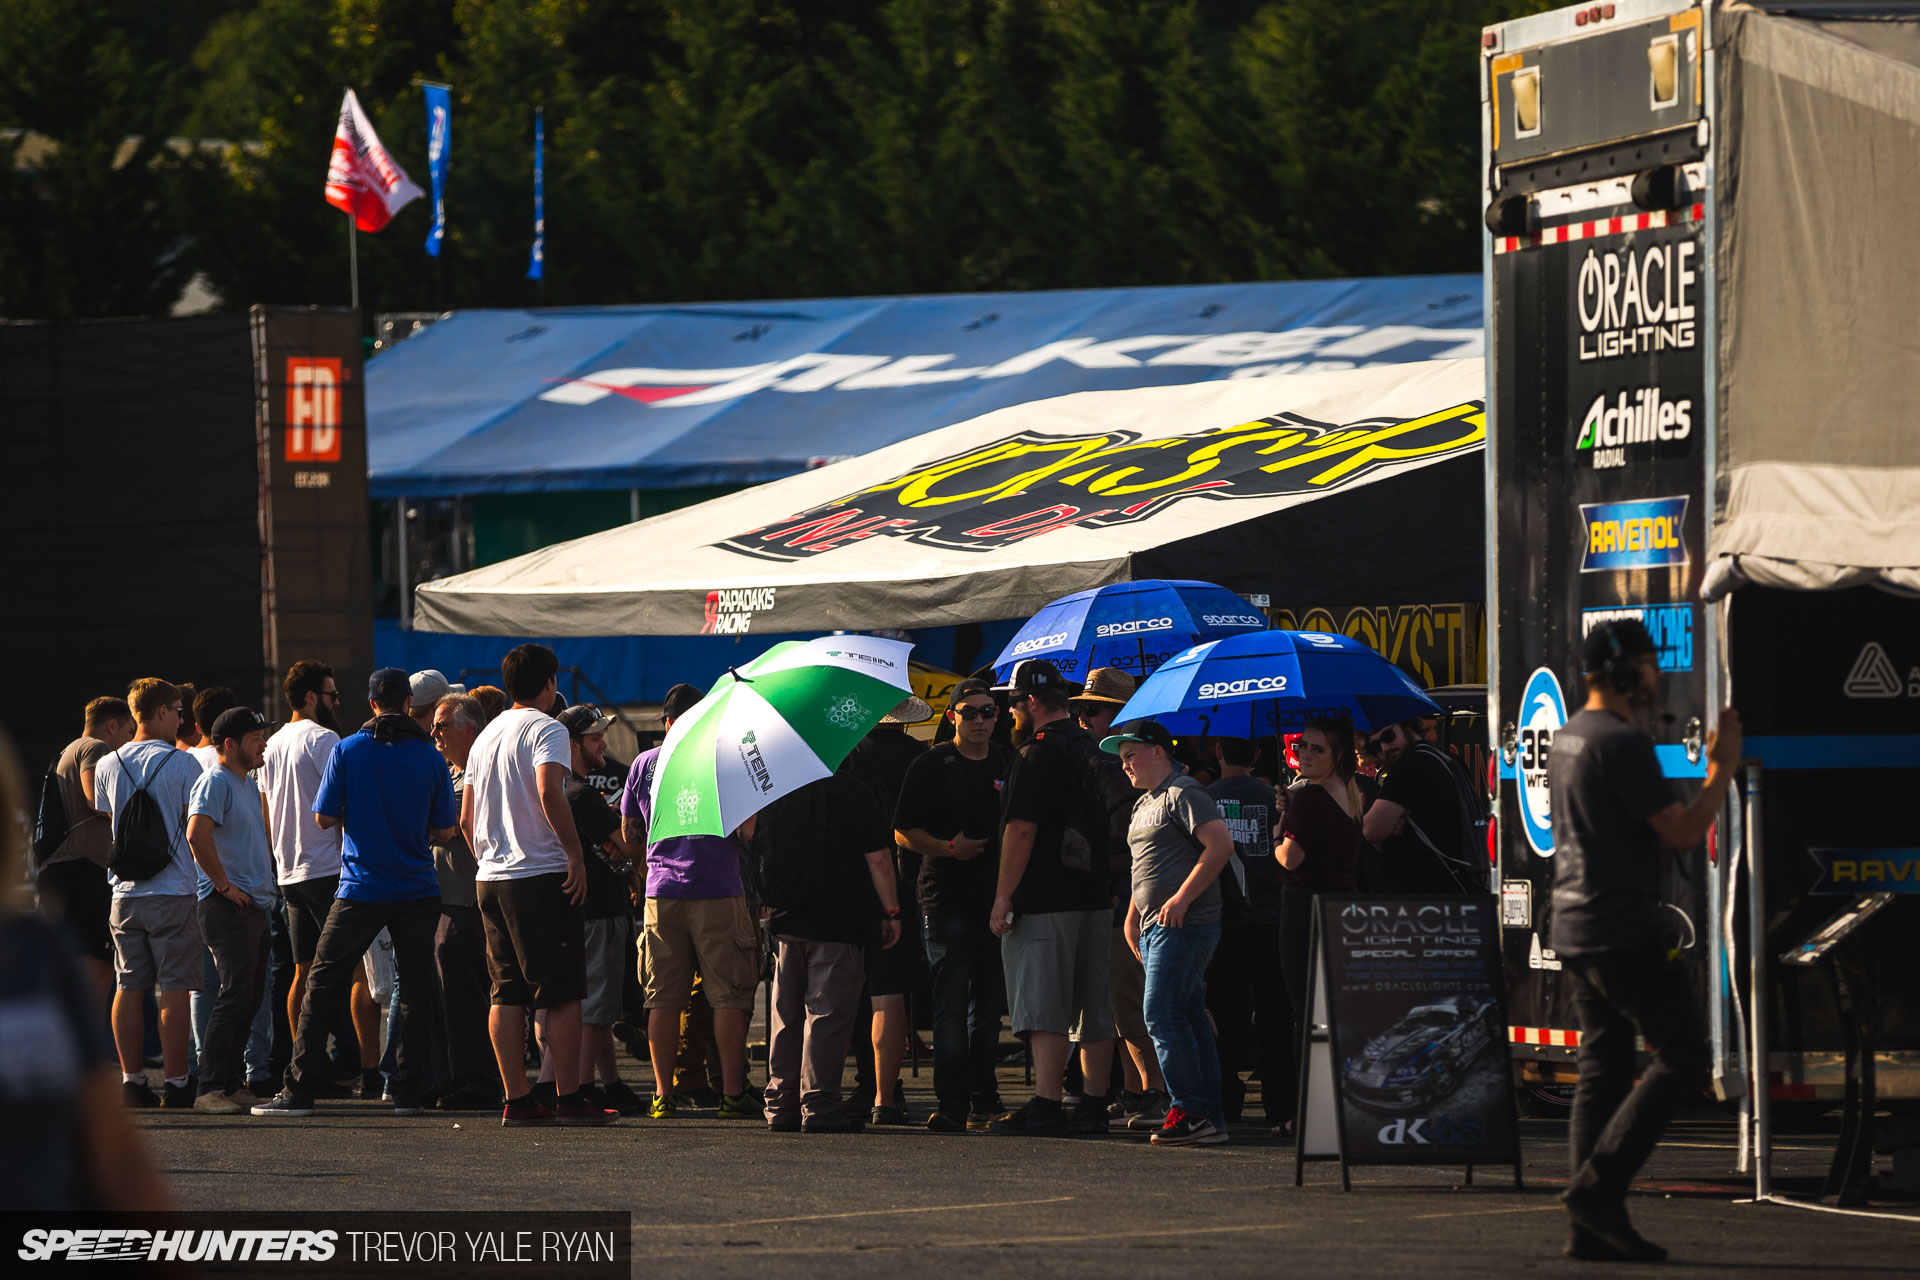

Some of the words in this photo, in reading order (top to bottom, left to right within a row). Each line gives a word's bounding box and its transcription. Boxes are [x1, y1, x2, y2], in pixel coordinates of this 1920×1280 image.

[1578, 241, 1695, 332] ORACLE
[1580, 321, 1695, 360] LIGHTING
[1576, 387, 1692, 450] Achilles
[1593, 448, 1626, 469] RADIAL
[1590, 516, 1679, 554] RAVENOL
[718, 588, 776, 612] PAPADAKIS
[714, 612, 751, 634] RACING
[1097, 617, 1173, 637] sparco
[1202, 614, 1261, 627] sparco
[1012, 631, 1068, 655] sparco
[1198, 675, 1287, 699] sparco
[1832, 859, 1920, 882] RAV
[1341, 903, 1480, 934] ORACLE
[1342, 935, 1482, 945] LIGHTING
[1351, 949, 1416, 958] SPECIAL
